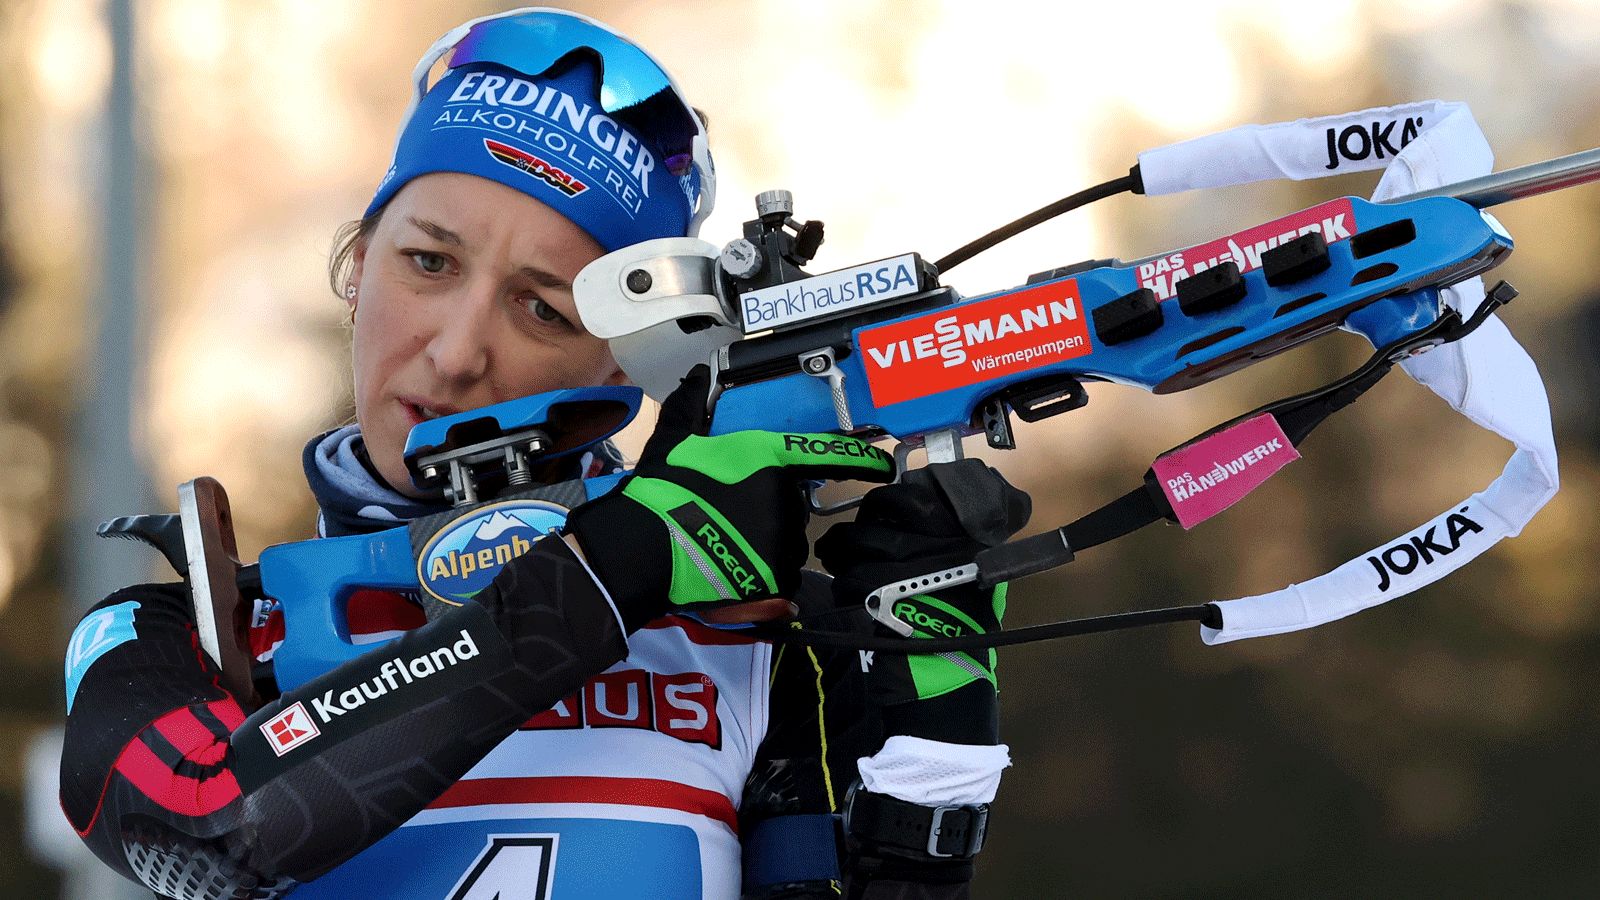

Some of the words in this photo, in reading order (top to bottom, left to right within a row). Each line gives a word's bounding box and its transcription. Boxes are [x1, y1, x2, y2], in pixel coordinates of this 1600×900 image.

[433, 109, 642, 214] ALKOHOLFREI
[448, 72, 655, 198] ERDINGER
[527, 157, 590, 198] DSV
[1139, 253, 1185, 280] DAS
[867, 297, 1078, 368] VIESSMANN
[971, 335, 1083, 372] Wärmepumpen
[1167, 472, 1193, 489] DAS
[1171, 438, 1283, 502] HANDWERK
[1367, 513, 1484, 592] JOKA
[311, 629, 480, 723] Kaufland
